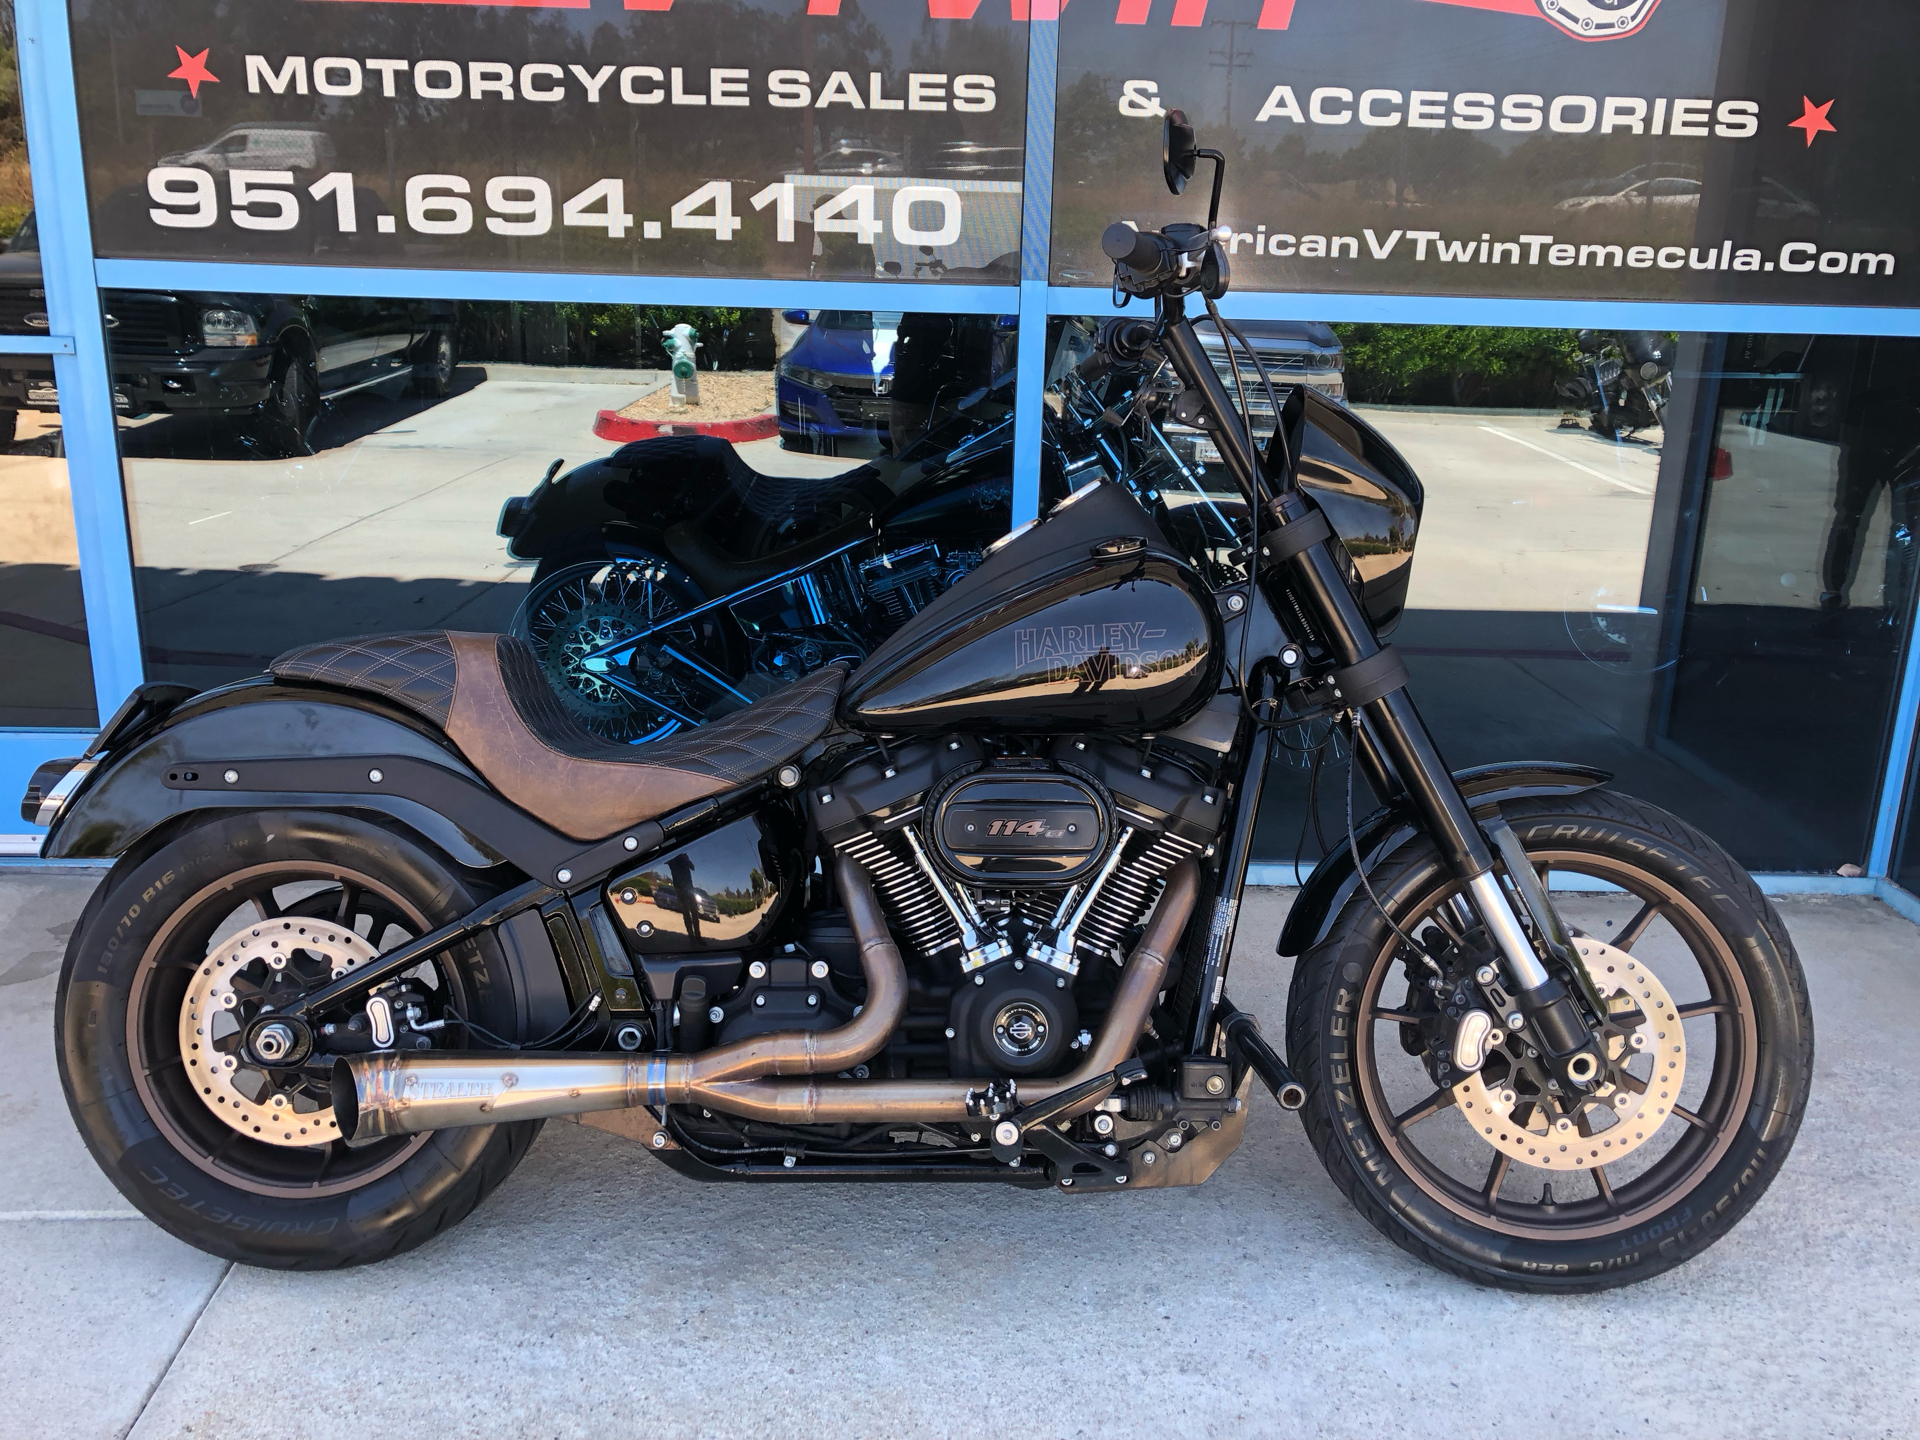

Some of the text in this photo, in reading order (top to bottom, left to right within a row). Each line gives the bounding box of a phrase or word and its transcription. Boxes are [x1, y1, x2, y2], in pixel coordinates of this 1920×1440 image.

[246, 54, 1760, 138] MOTORCYCLE SALES & ACCESSORIES
[146, 166, 963, 247] 951.694.4140
[1121, 220, 1896, 276] ricanVTwinTemecula.Com
[1014, 621, 1167, 669] HARLEY-
[1046, 648, 1200, 684] DAVIDSON
[986, 818, 1050, 838] 114
[1525, 823, 1741, 913] CRUISETEC
[97, 903, 142, 975] 180/70
[141, 869, 177, 904] B16
[1329, 987, 1394, 1187] METZELER
[139, 1165, 340, 1237] CRUISETEC
[1618, 1206, 1694, 1252] FRONT
